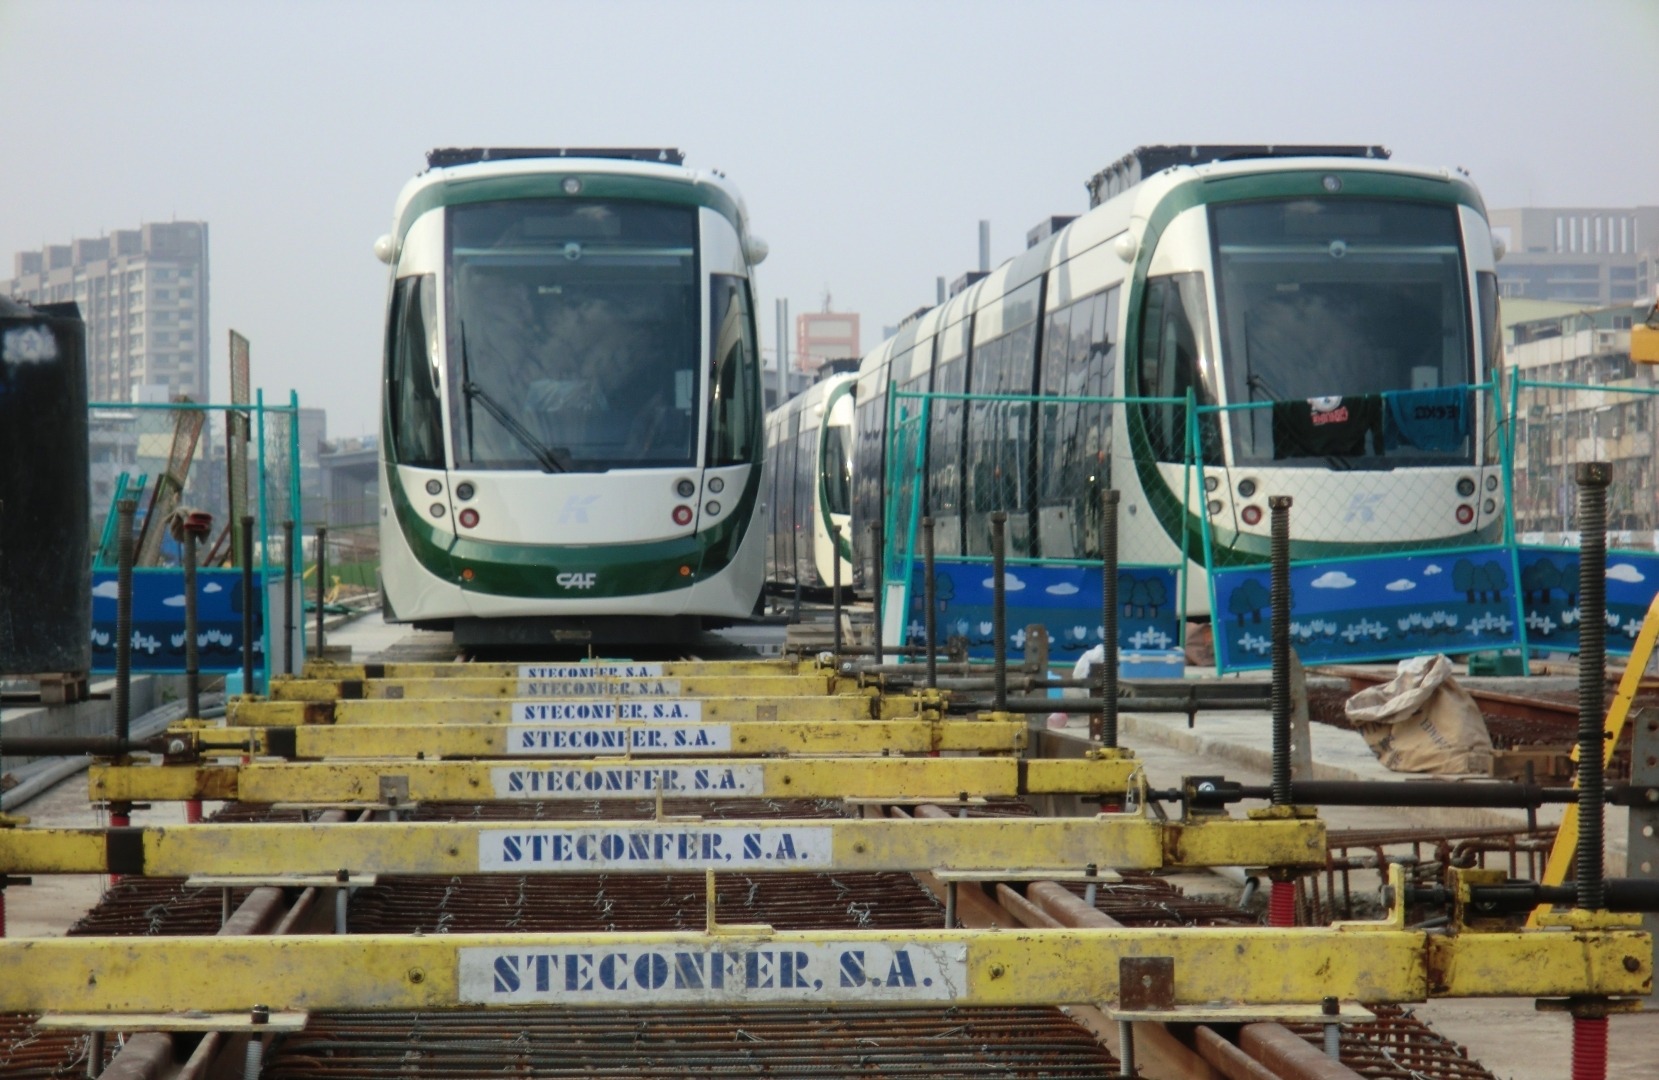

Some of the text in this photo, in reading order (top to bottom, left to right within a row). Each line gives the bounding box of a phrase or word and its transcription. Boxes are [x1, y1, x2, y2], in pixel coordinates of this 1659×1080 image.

[556, 573, 596, 589] CAF
[639, 681, 670, 695] S.A.
[525, 704, 689, 719] STECONFER, S.A.
[674, 730, 717, 746] S.A.
[508, 769, 745, 792] STECONFER, S.A.
[503, 833, 809, 862] STECONFER, S.A.
[493, 950, 933, 993] STECONFER, S.A.
